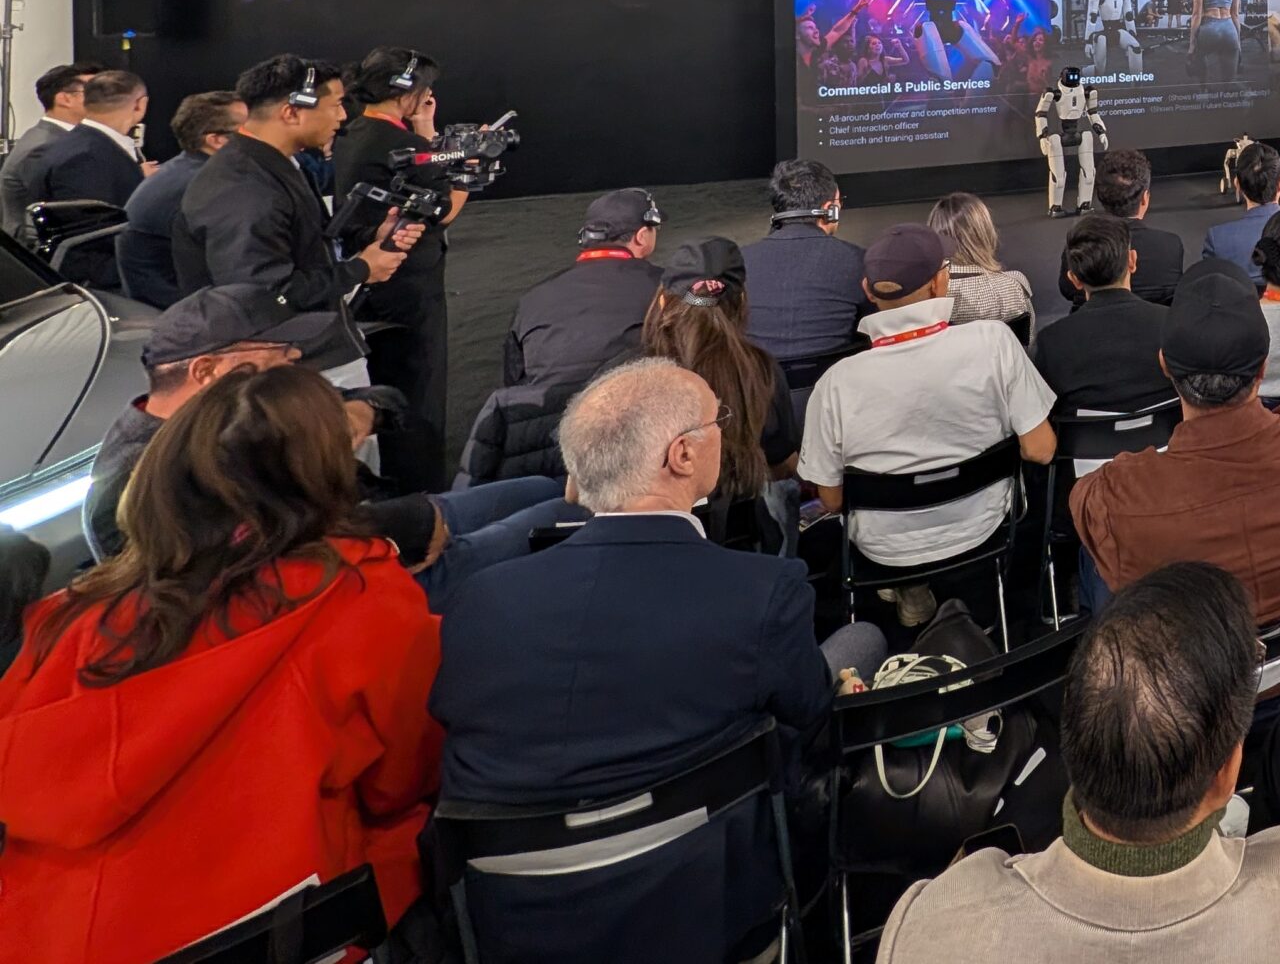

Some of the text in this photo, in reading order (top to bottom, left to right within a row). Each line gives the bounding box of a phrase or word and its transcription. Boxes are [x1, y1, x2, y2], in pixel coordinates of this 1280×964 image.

[1080, 72, 1154, 84] ersonal Service
[818, 78, 990, 98] Commercial & Public Services
[1114, 97, 1141, 106] personal
[1142, 96, 1163, 104] trainer
[829, 106, 997, 123] All-around performer and competition master
[1109, 108, 1145, 116] companion
[829, 122, 919, 134] Chief interaction officer
[829, 132, 949, 147] Research and training assistant
[431, 151, 465, 162] RONIN
